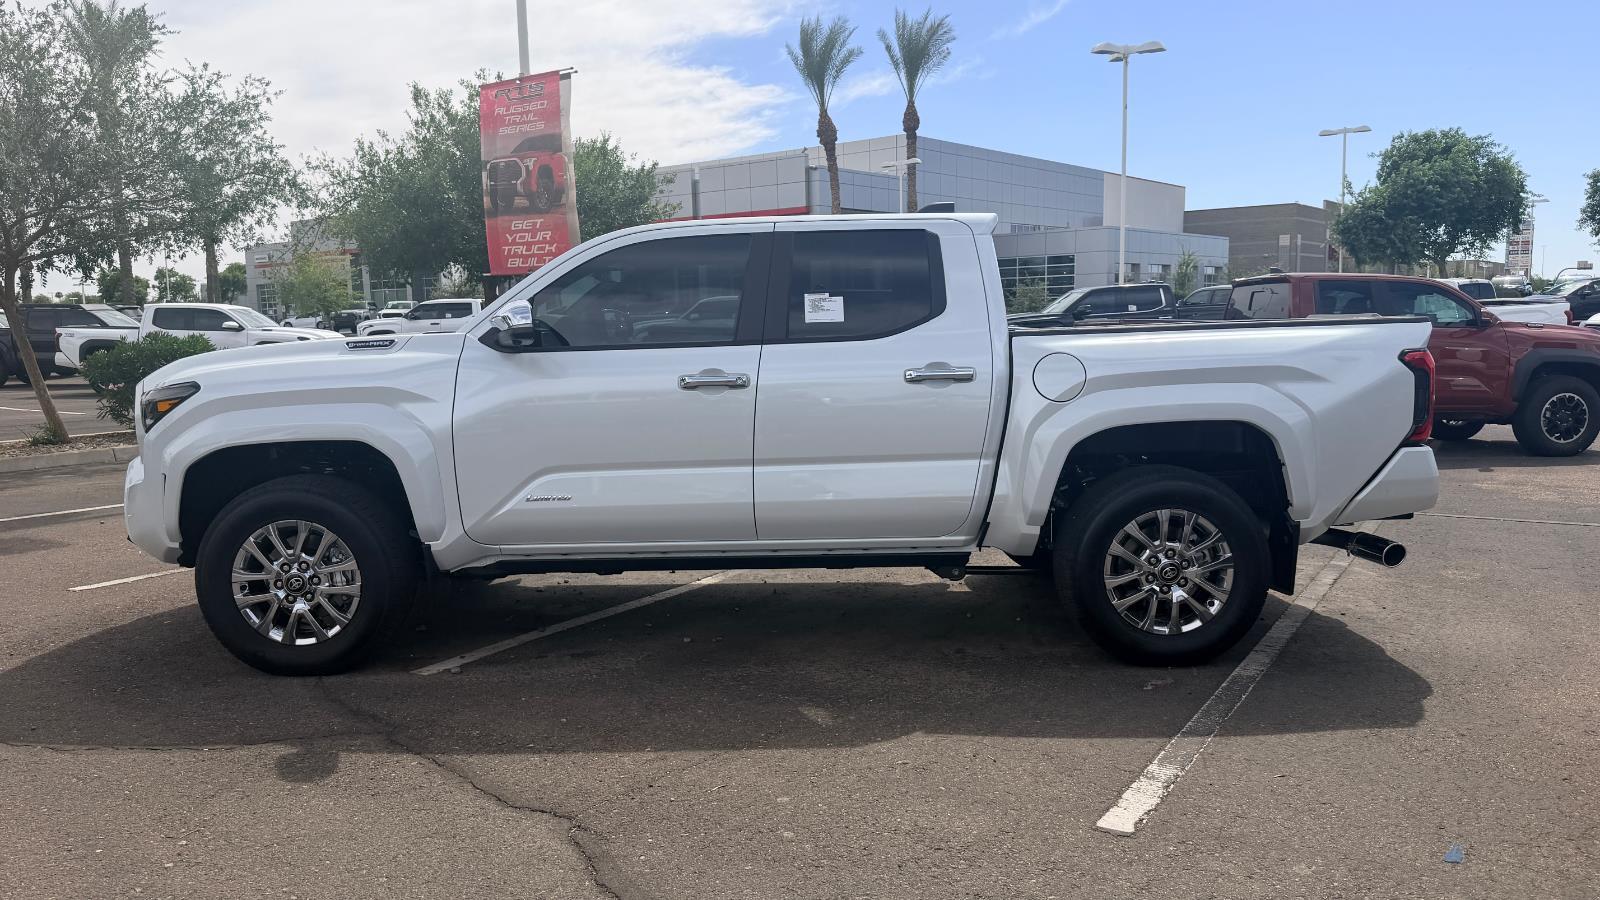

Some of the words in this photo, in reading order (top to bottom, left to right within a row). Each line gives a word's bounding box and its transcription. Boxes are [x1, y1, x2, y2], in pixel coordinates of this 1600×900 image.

[494, 100, 548, 116] RUGGED
[504, 112, 539, 125] TRAIL
[498, 121, 545, 135] SERIES
[511, 219, 544, 231] GET
[505, 231, 552, 243] YOUR
[502, 243, 558, 256] TRUCK
[507, 256, 553, 268] BUILT
